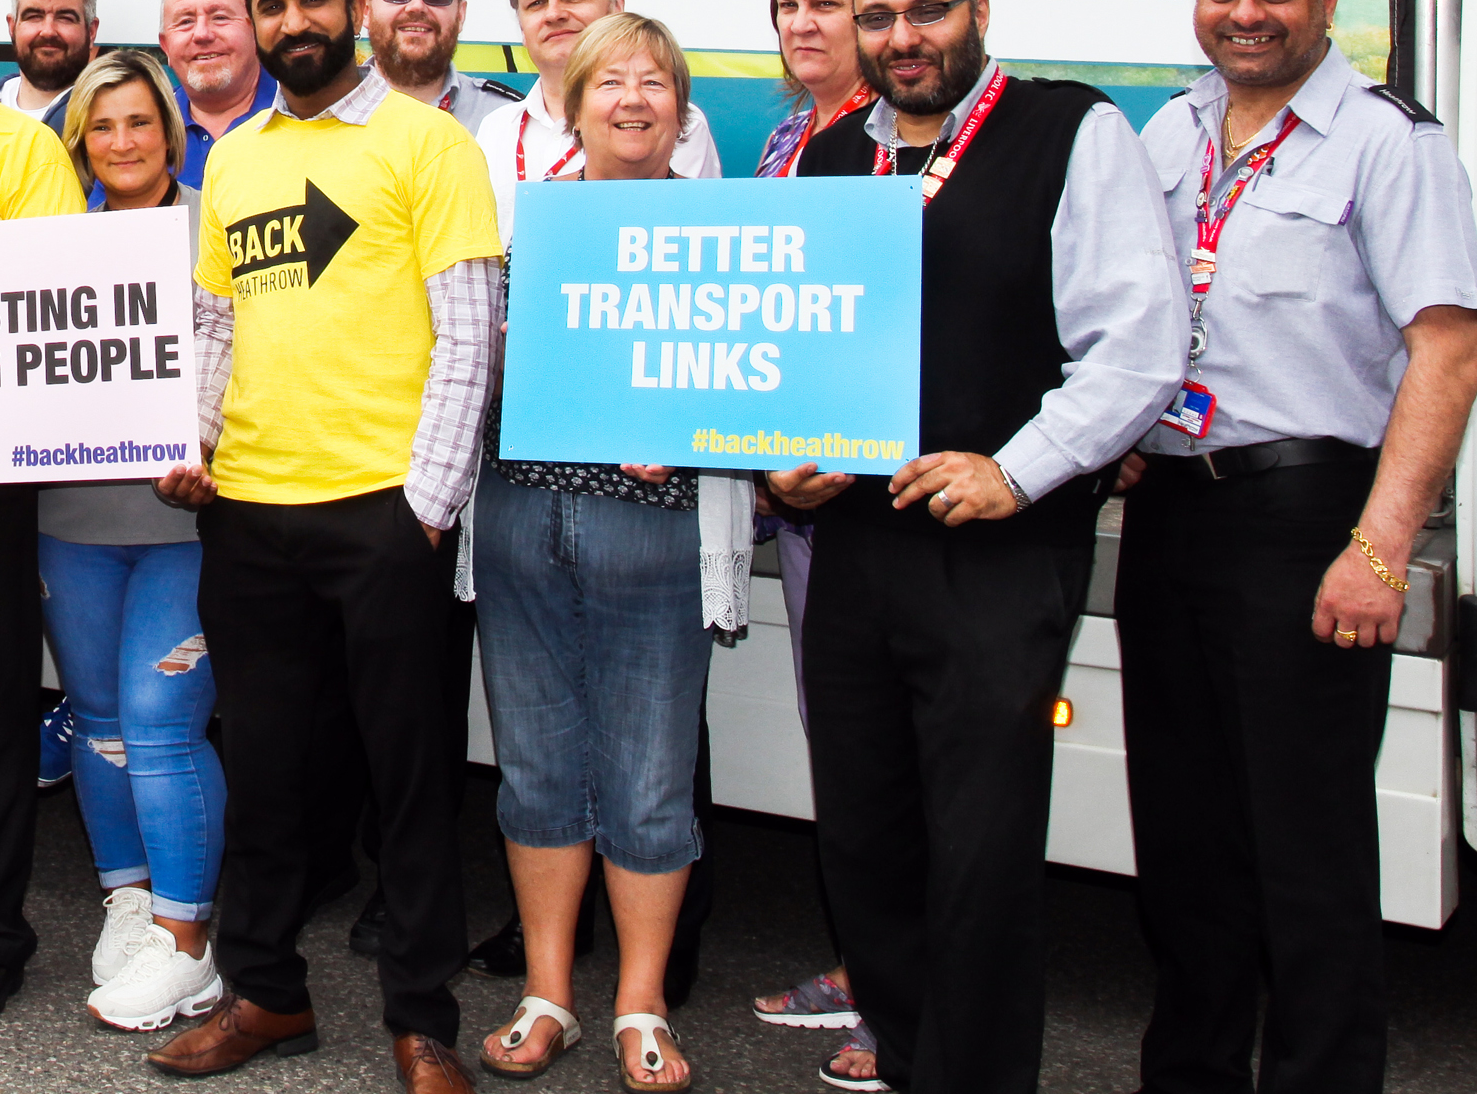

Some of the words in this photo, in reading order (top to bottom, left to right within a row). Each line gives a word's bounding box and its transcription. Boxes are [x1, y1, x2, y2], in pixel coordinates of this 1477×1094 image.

[947, 117, 980, 161] LIVERPOO
[229, 214, 306, 269] BACK
[617, 225, 806, 273] BETTER
[114, 281, 158, 327] IN
[235, 268, 304, 303] HEATHROW
[560, 283, 864, 333] TRANSPORT
[16, 334, 181, 387] PEOPLE
[630, 341, 781, 391] LINKS
[11, 439, 187, 469] #backheathrow
[691, 428, 905, 461] #backheathrow
